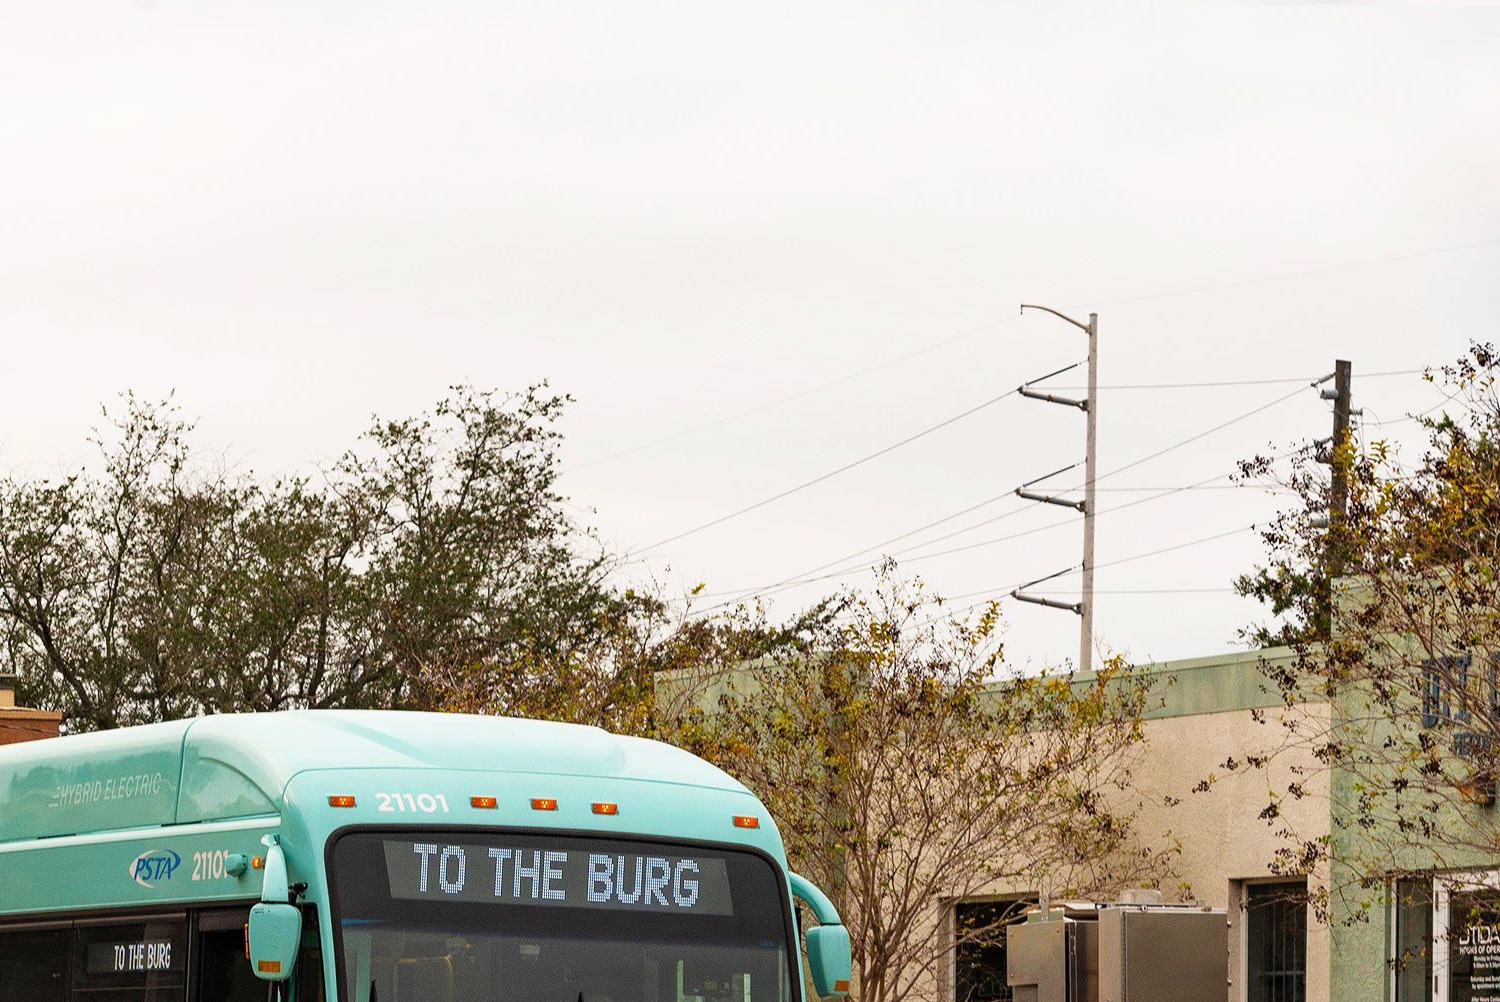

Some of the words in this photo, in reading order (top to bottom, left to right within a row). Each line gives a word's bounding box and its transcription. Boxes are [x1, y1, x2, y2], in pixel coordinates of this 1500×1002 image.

[59, 780, 102, 807] HYBRID
[104, 772, 162, 799] ELECTRIC
[375, 792, 450, 814] 21101
[134, 849, 181, 881] PSTA
[413, 843, 466, 893] TO
[487, 848, 568, 901] THE
[586, 853, 700, 908] BURG
[114, 945, 125, 971] TO
[128, 944, 144, 970] THE
[147, 943, 171, 969] BURG
